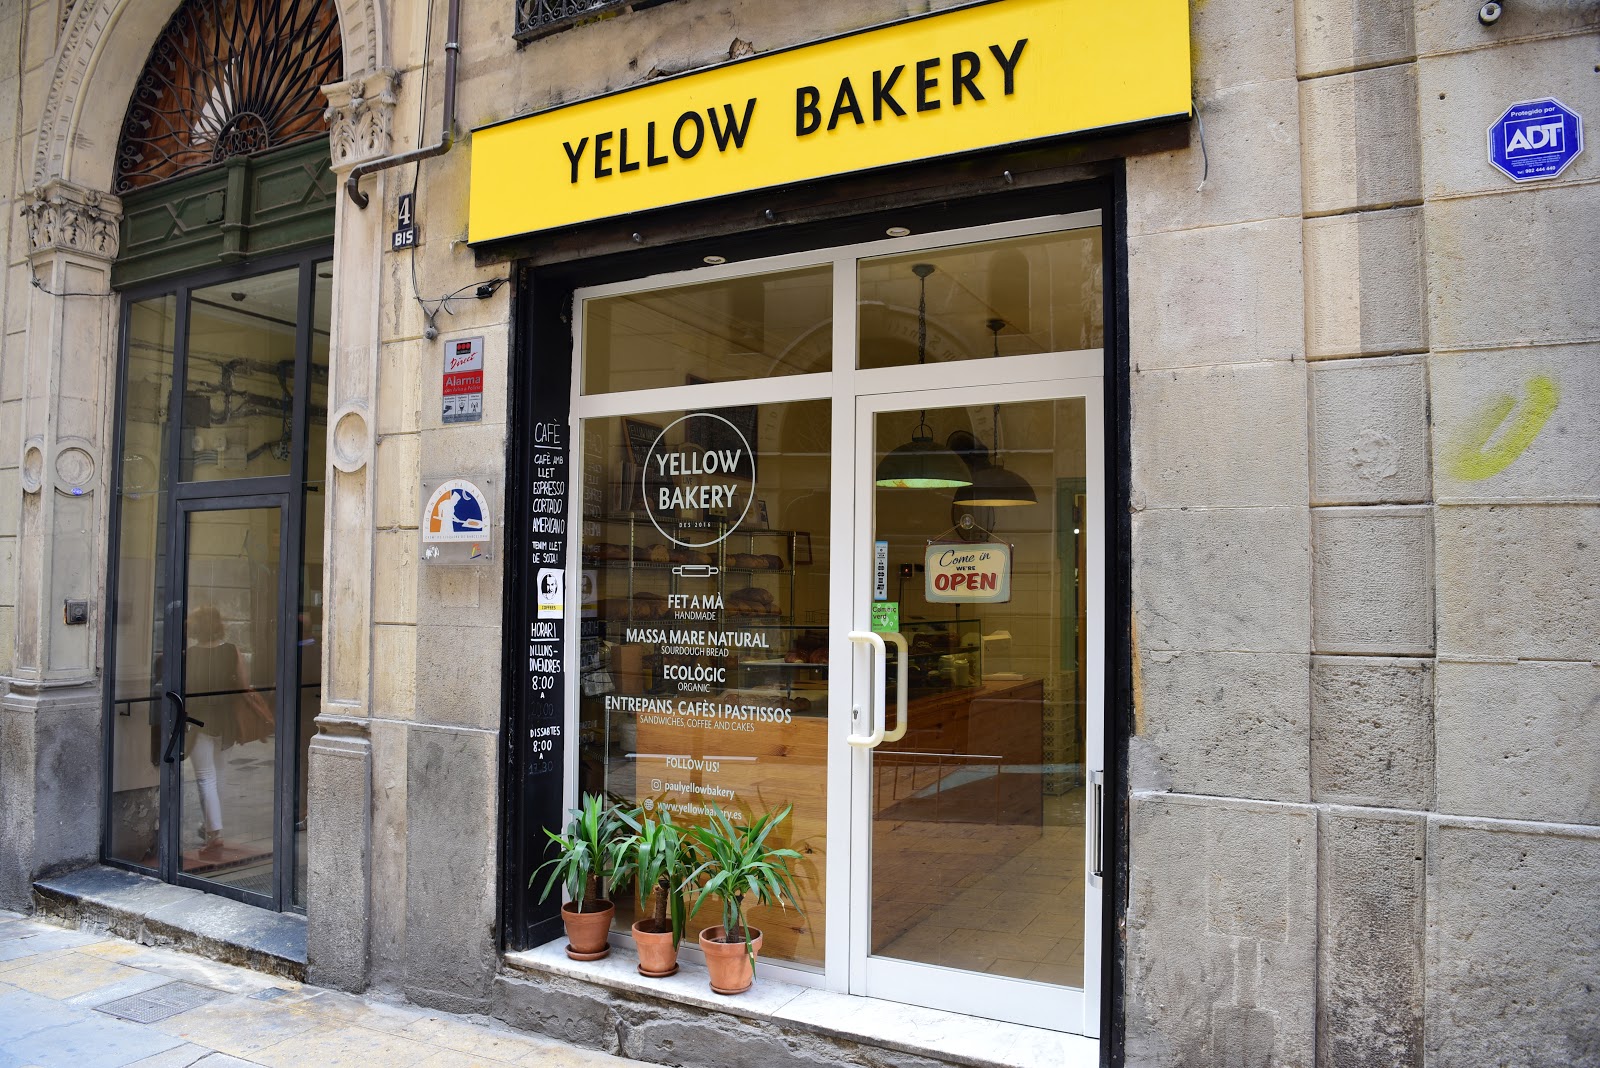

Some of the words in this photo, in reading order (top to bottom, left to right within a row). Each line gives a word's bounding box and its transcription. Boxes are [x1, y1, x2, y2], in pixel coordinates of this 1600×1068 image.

[562, 97, 757, 184] YELLOW
[795, 38, 1028, 137] BAKERY
[1510, 108, 1543, 117] Protegido
[1544, 106, 1556, 114] por
[1507, 122, 1563, 152] ADT
[398, 197, 410, 225] 4
[395, 230, 414, 246] BIS
[445, 376, 481, 386] Alarma
[534, 418, 561, 444] CAFÈ
[534, 452, 551, 465] CAFÈ
[656, 449, 741, 476] YELLOW
[537, 467, 556, 478] LLET
[533, 481, 565, 496] ESPRESSO
[659, 484, 738, 510] BAKERY
[532, 498, 563, 514] CORTADO
[532, 517, 565, 534] AMERICANO
[548, 541, 562, 551] LLET
[532, 553, 541, 563] DE
[939, 549, 975, 567] Come
[979, 551, 991, 561] in
[934, 573, 997, 592] OPEN
[668, 594, 690, 609] FET
[690, 595, 700, 609] A
[702, 591, 724, 610] MÀ
[674, 611, 716, 621] HANDMADE
[531, 622, 557, 638] HORARI
[626, 628, 667, 644] MASSA
[669, 629, 705, 646] MARE
[708, 631, 769, 648] NATURAL
[661, 645, 705, 656] SOURDOUGH
[706, 648, 729, 657] BREAD
[663, 663, 726, 682] ECOLÒGIC
[532, 675, 554, 690] 8:00
[677, 682, 711, 693] ORGANIC
[605, 695, 676, 716] ENTREPANS,
[678, 699, 716, 718] CAFÈS
[718, 704, 722, 718] I
[725, 704, 792, 724] PASTISSOS
[639, 714, 686, 728] SANDWICHES,
[686, 718, 712, 729] COFFEE
[713, 720, 730, 730] AND
[731, 721, 755, 732] CAKES
[529, 726, 561, 738] DISSABTES
[533, 740, 553, 752] 8:00
[539, 752, 544, 760] A
[666, 756, 705, 771] FOLLOW
[705, 761, 720, 773] US!
[664, 781, 735, 800] paulyellowbakery
[657, 801, 742, 821] www.yellowbary.es
